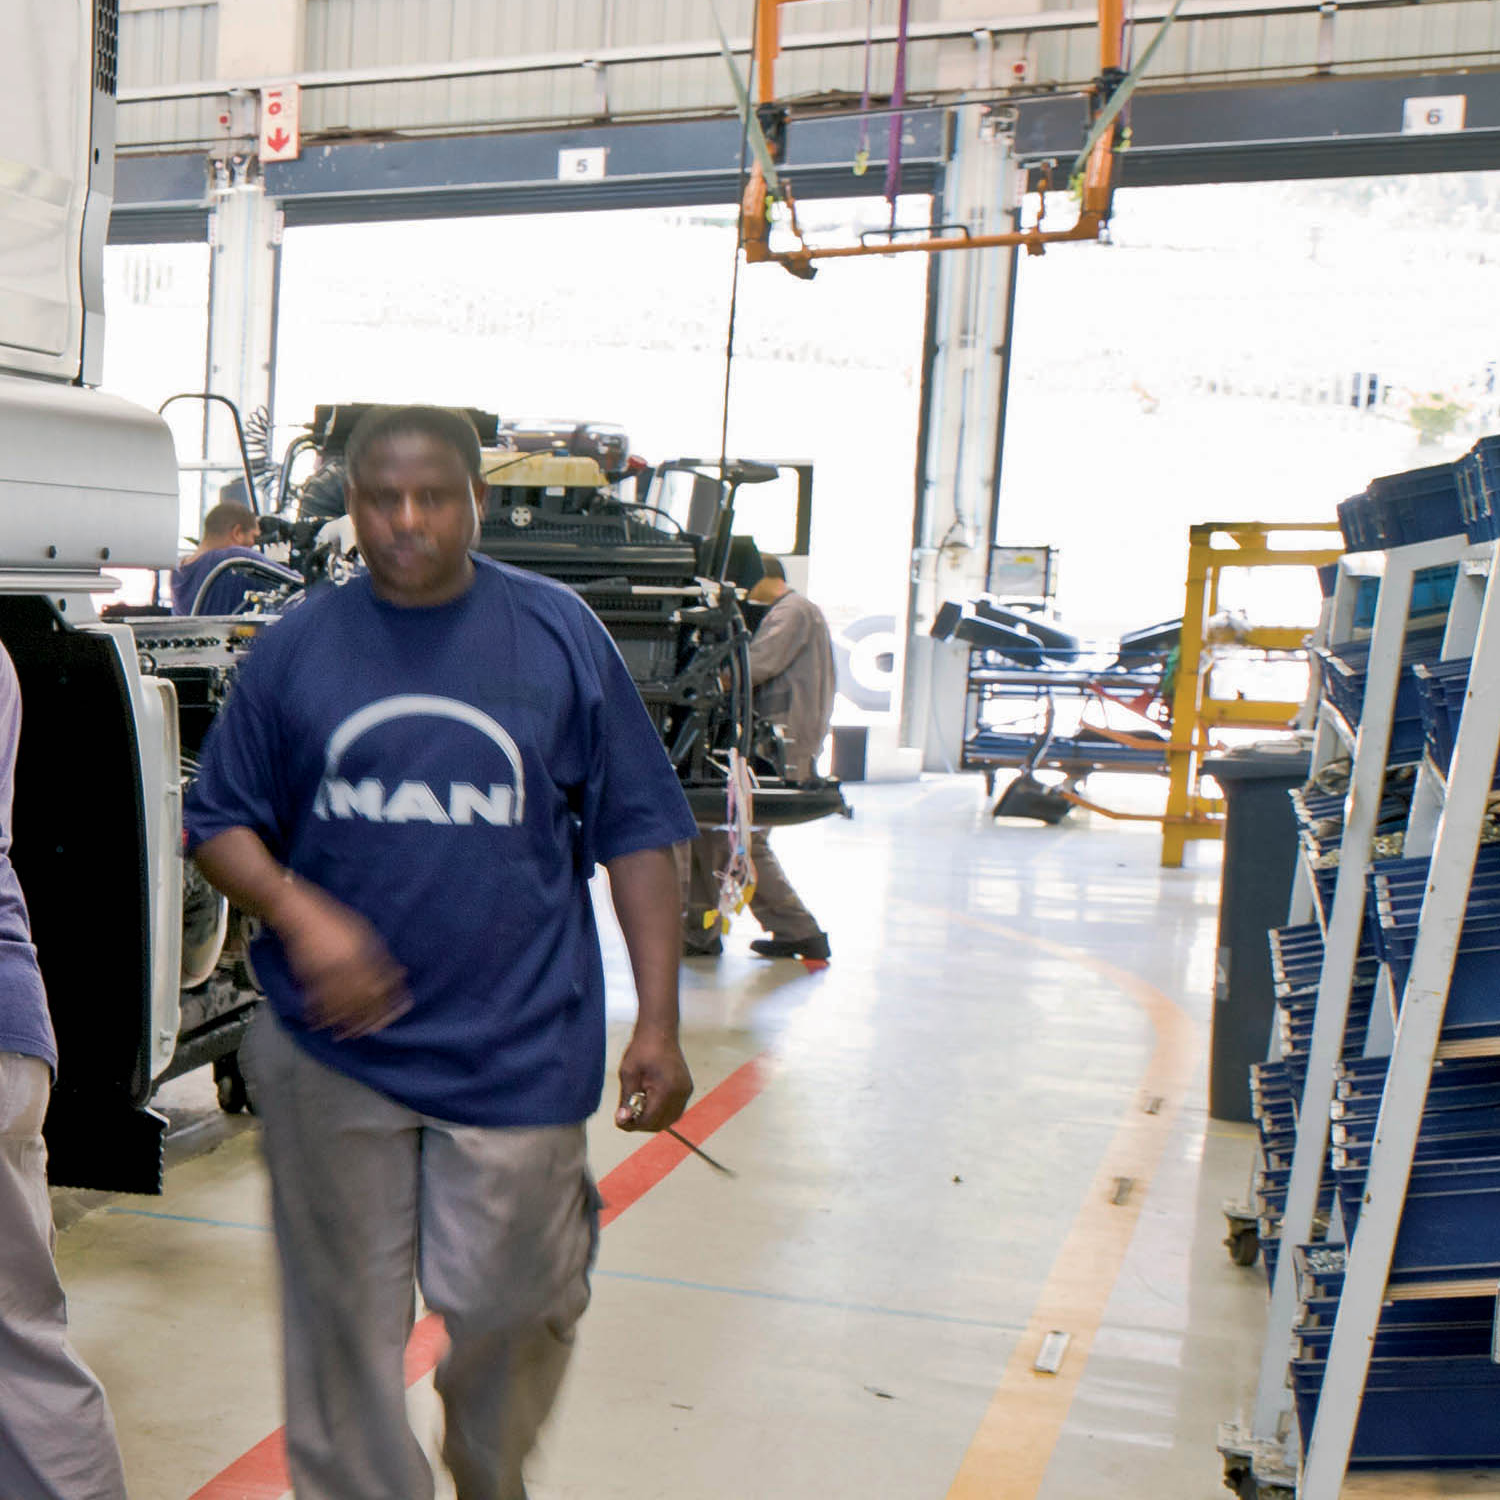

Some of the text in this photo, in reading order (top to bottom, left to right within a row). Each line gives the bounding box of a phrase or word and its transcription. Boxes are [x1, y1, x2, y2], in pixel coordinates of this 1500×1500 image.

[1425, 108, 1441, 125] 6
[576, 158, 589, 173] 5
[325, 777, 514, 827] MAN
